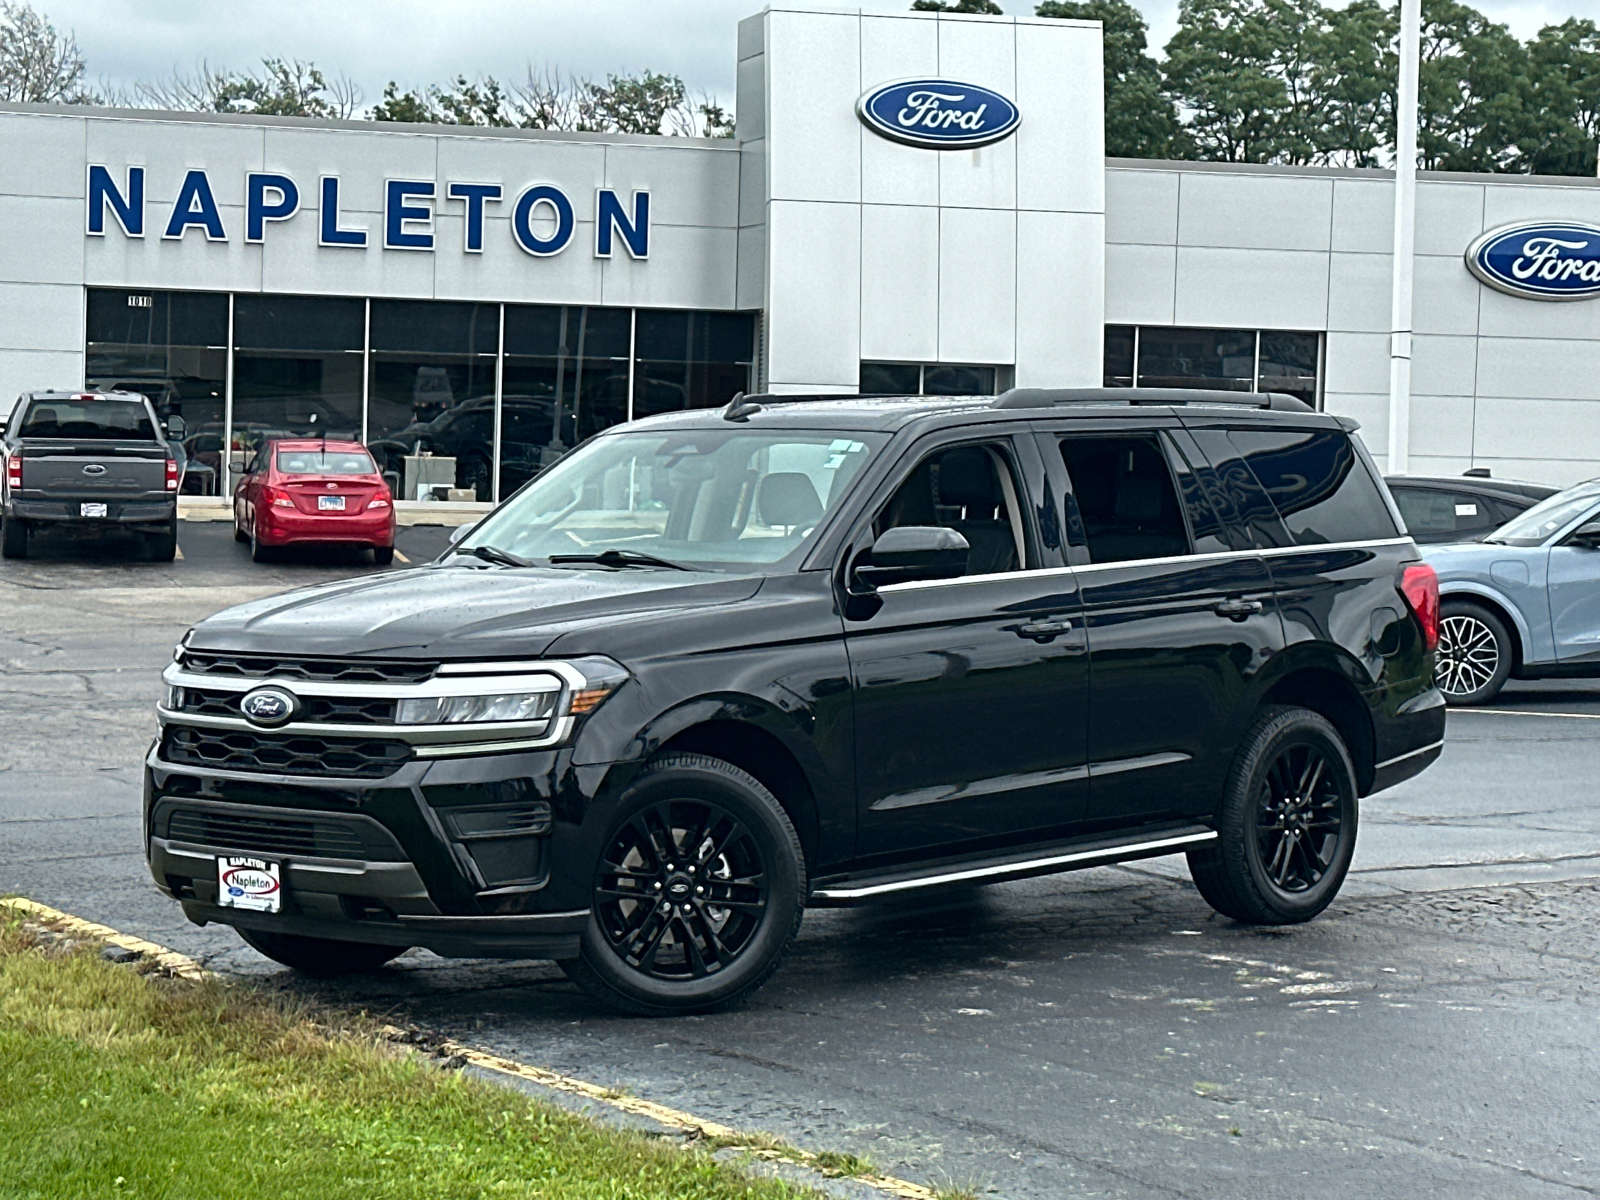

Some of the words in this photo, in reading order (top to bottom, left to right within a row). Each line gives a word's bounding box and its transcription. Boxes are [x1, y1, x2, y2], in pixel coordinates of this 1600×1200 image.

[897, 91, 987, 130] Ford
[86, 163, 650, 260] NAPLETON
[128, 295, 152, 307] 1010
[250, 696, 280, 714] Ford
[229, 857, 266, 869] NAPLETON
[231, 872, 271, 889] Napleton
